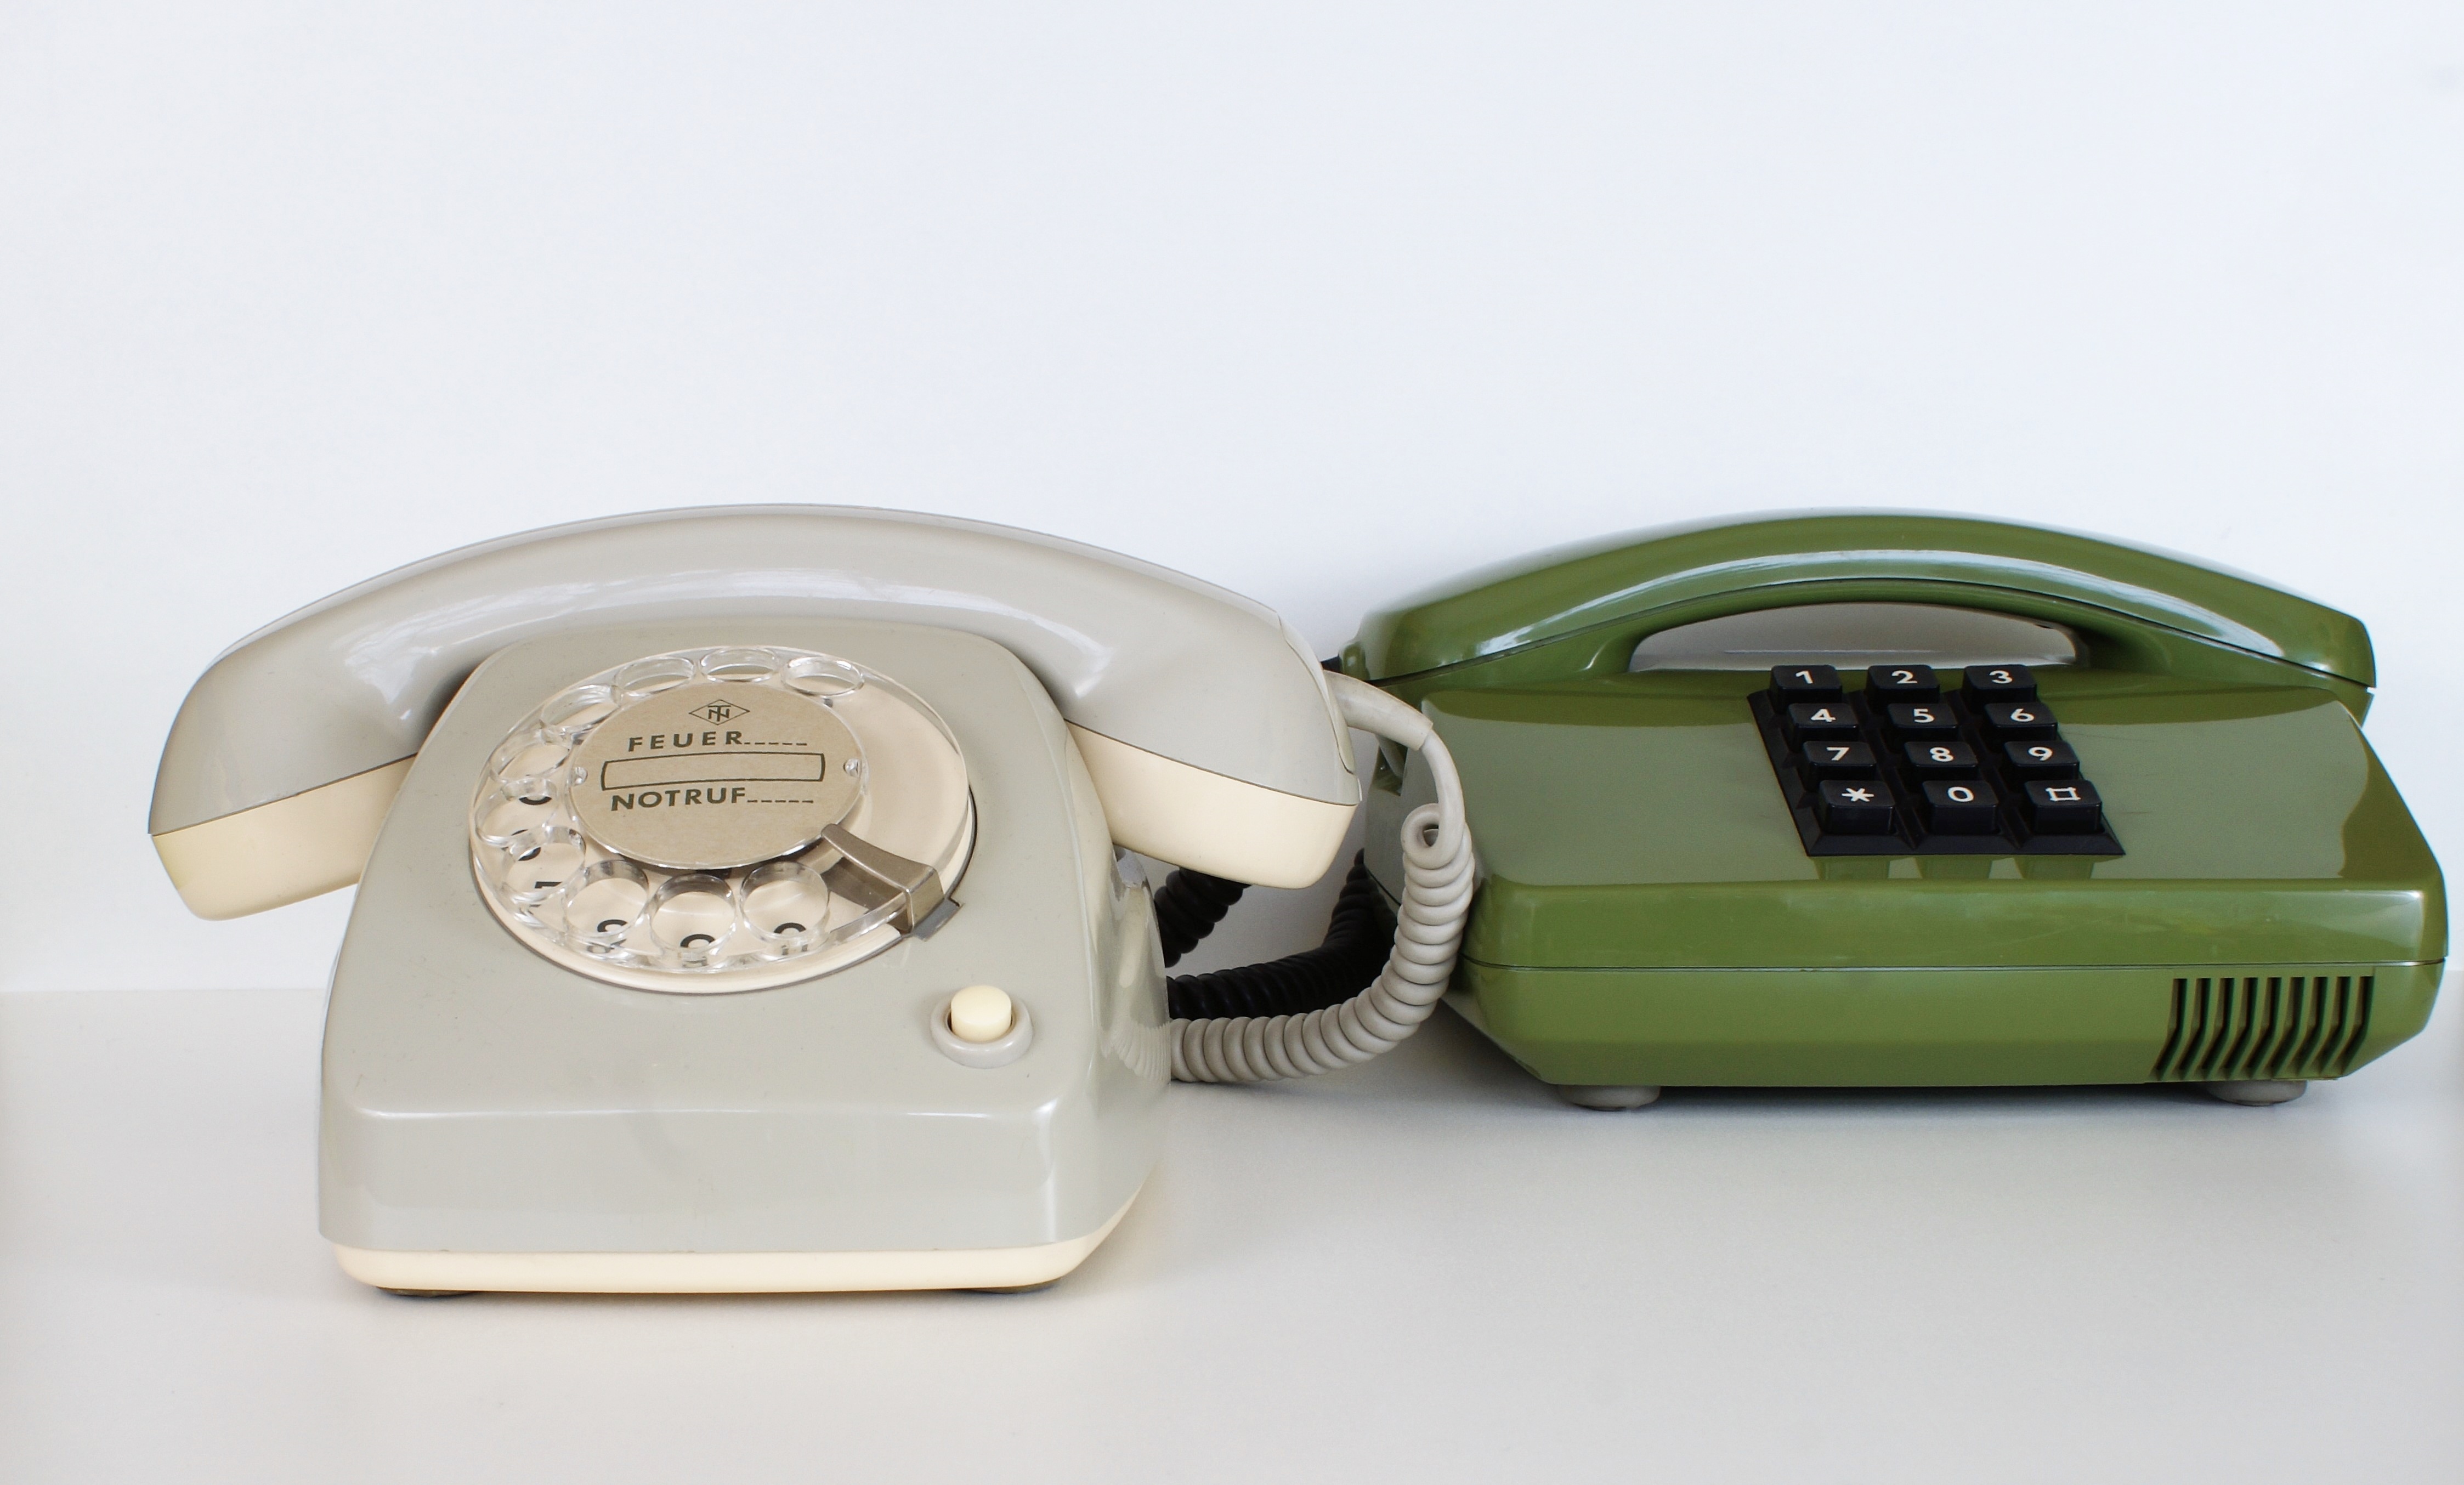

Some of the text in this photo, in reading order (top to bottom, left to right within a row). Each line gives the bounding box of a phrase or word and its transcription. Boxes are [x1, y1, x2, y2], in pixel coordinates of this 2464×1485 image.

[1795, 670, 2013, 684] 1 2 3
[1810, 708, 2035, 723] 4 5 6
[628, 730, 743, 752] FEUER
[1826, 746, 2053, 762] 7 8 9
[611, 787, 746, 812] NOTRUF
